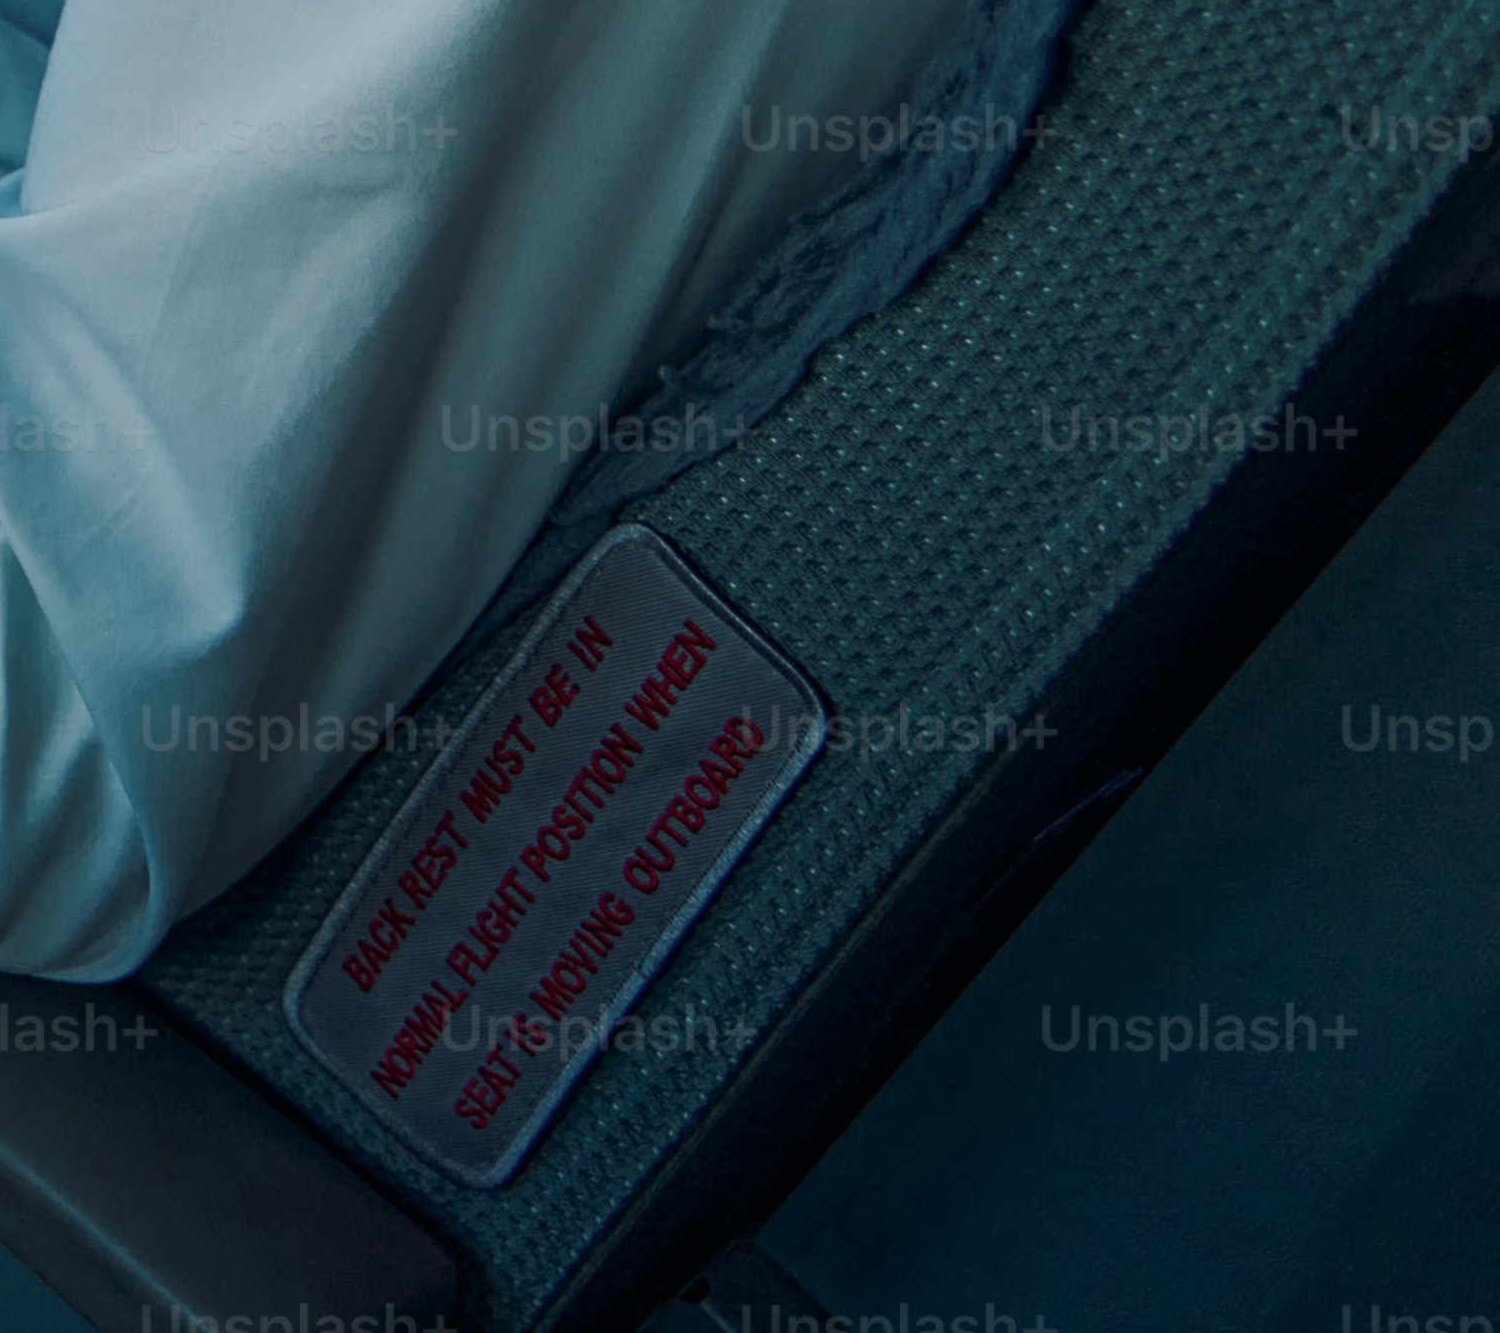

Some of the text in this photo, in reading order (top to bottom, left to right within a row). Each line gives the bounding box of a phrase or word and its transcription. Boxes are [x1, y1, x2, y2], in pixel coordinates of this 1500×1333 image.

[342, 615, 613, 994] BACK REST MUST BE IN
[370, 618, 718, 1101] NORMAL FLIGHT POSITION WHEN
[453, 715, 765, 1130] SEAT IS MOVING OUTBOARD
